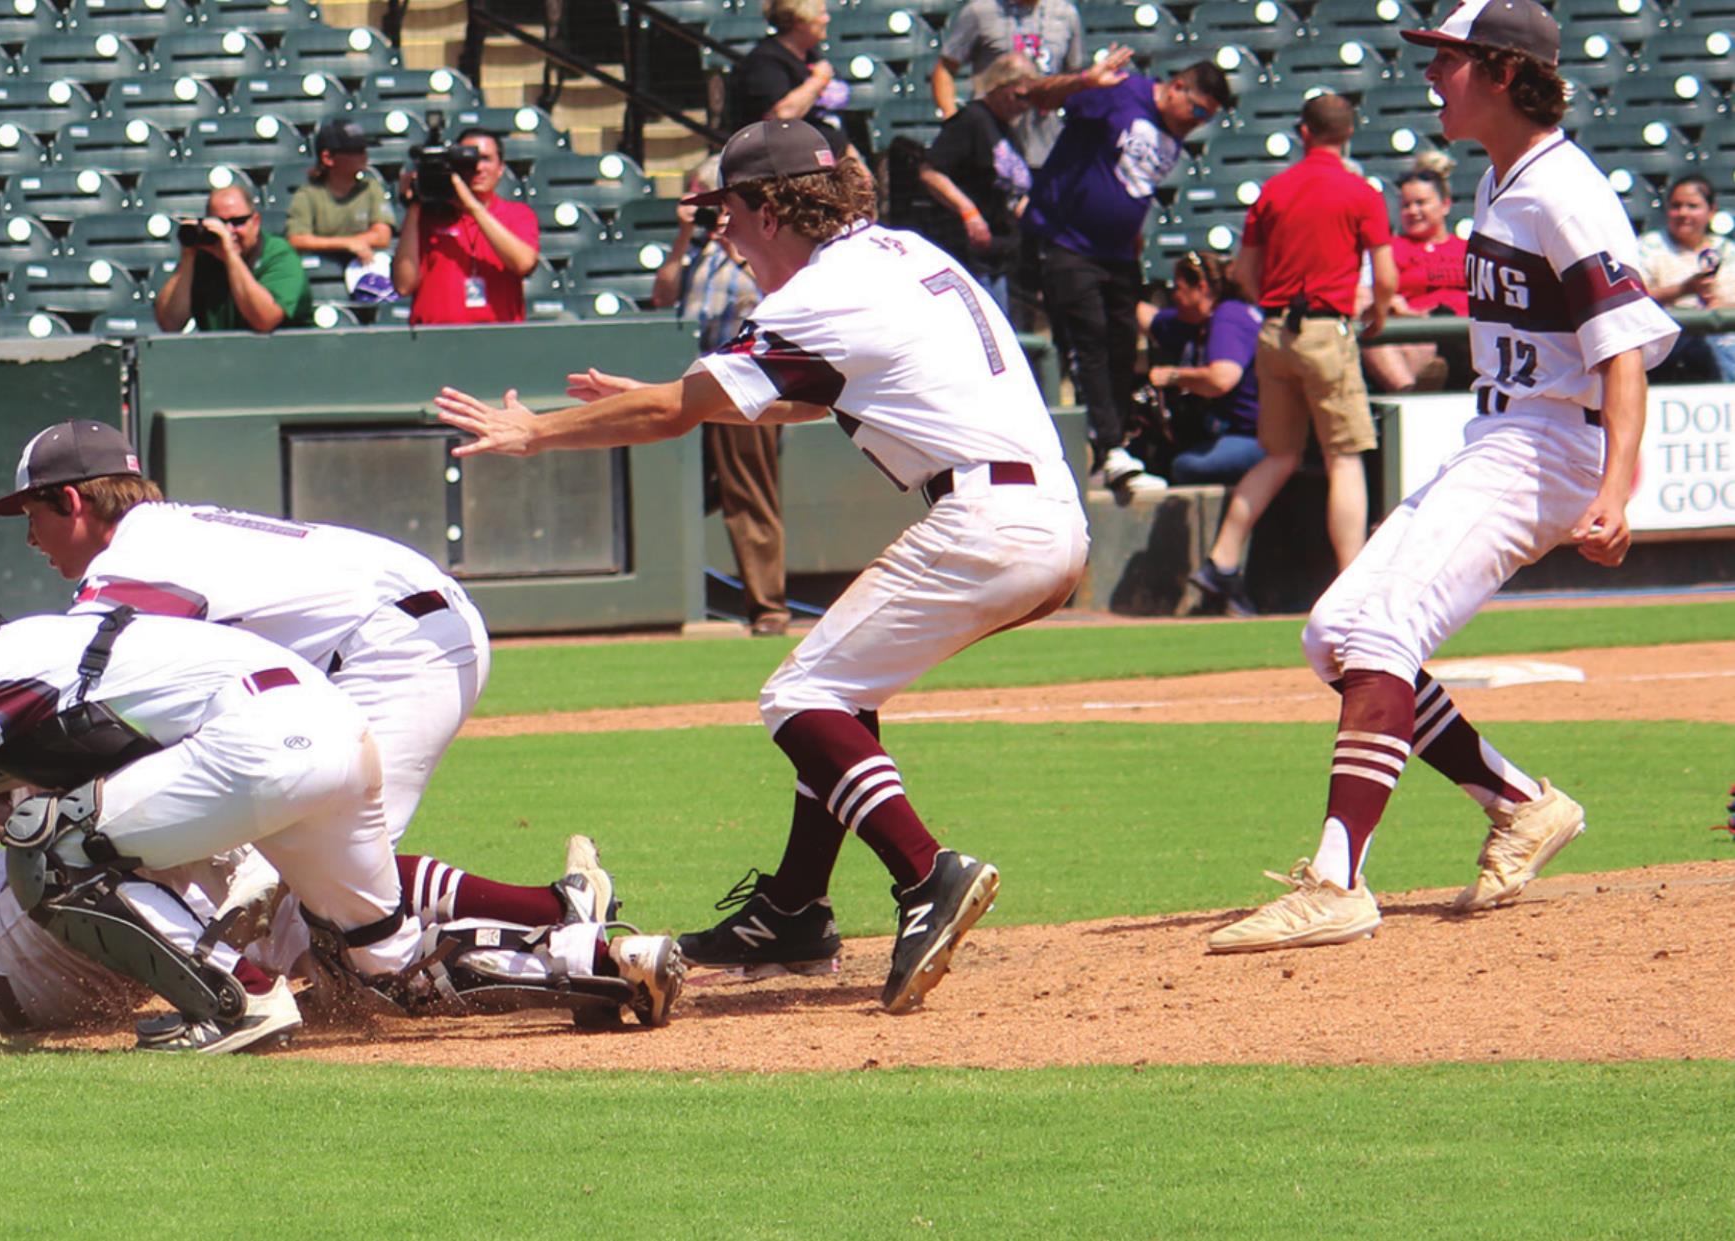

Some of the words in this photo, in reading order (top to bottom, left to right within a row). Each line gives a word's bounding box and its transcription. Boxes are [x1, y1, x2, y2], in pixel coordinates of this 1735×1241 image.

[921, 267, 1006, 376] 7
[1495, 336, 1537, 389] 12
[1658, 442, 1731, 474] THE
